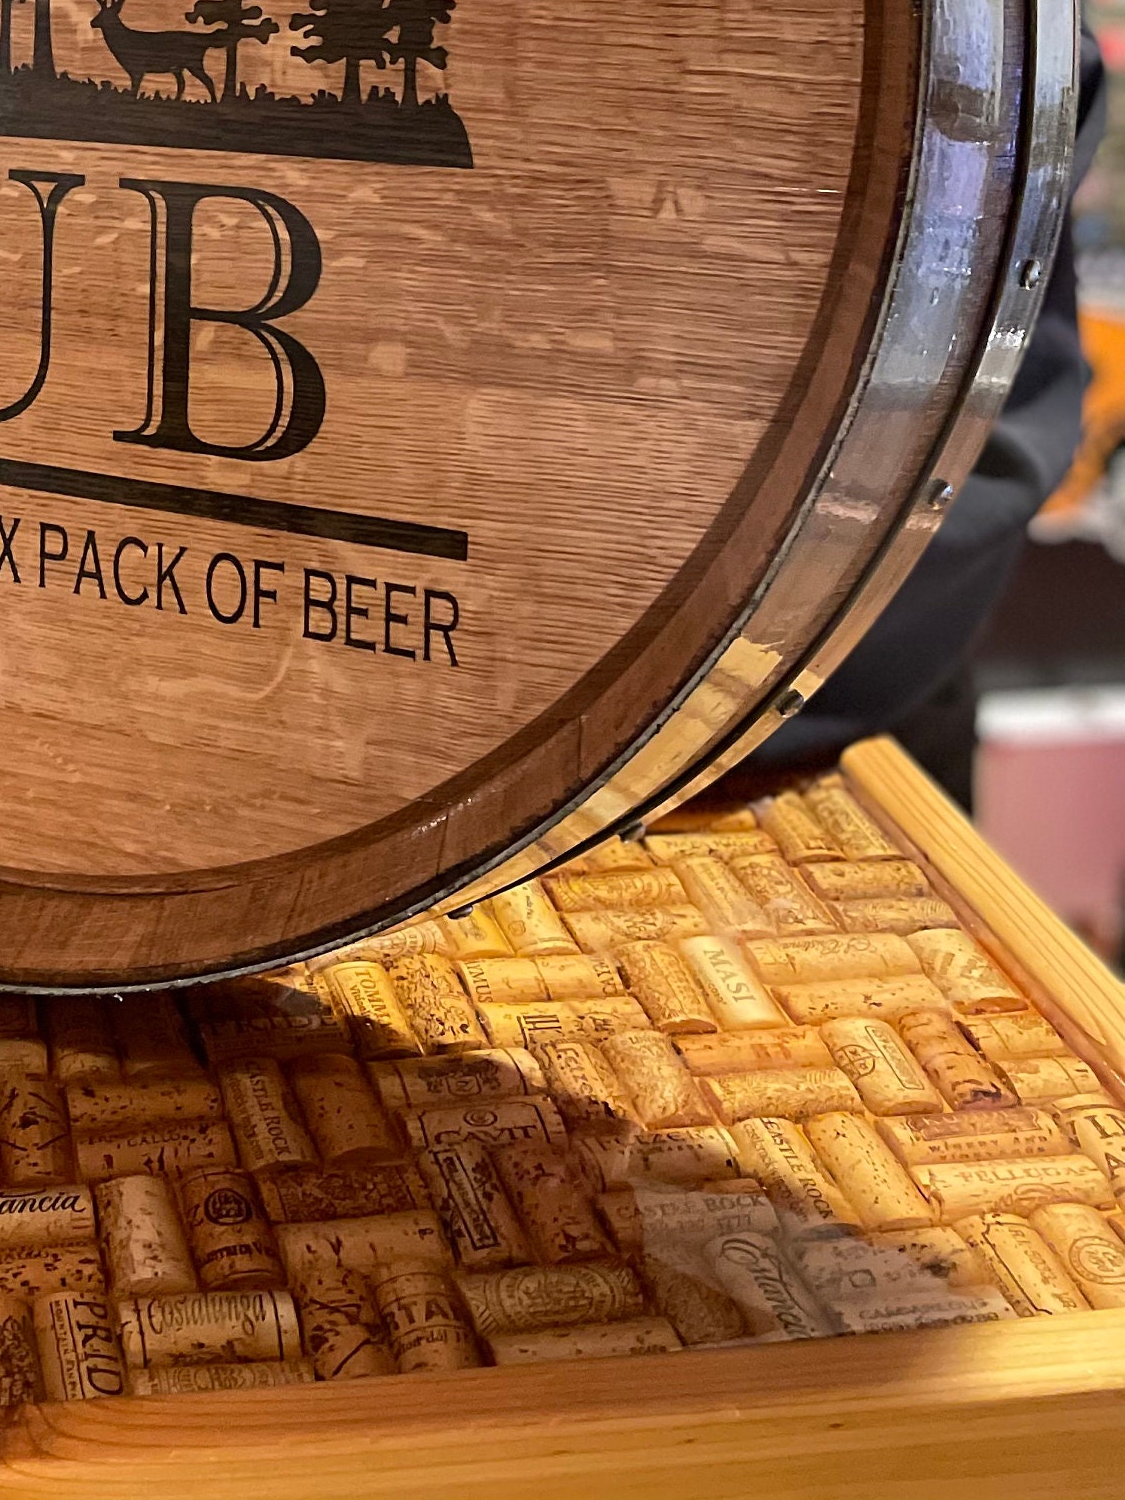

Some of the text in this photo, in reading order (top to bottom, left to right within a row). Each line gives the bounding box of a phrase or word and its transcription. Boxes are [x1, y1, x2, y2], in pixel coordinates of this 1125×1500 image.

[37, 521, 189, 616] PACK
[205, 552, 286, 630] OF
[302, 567, 461, 668] BEER
[703, 948, 757, 1003] MASI
[264, 1114, 293, 1158] ROCK
[798, 1174, 835, 1220] ROCK
